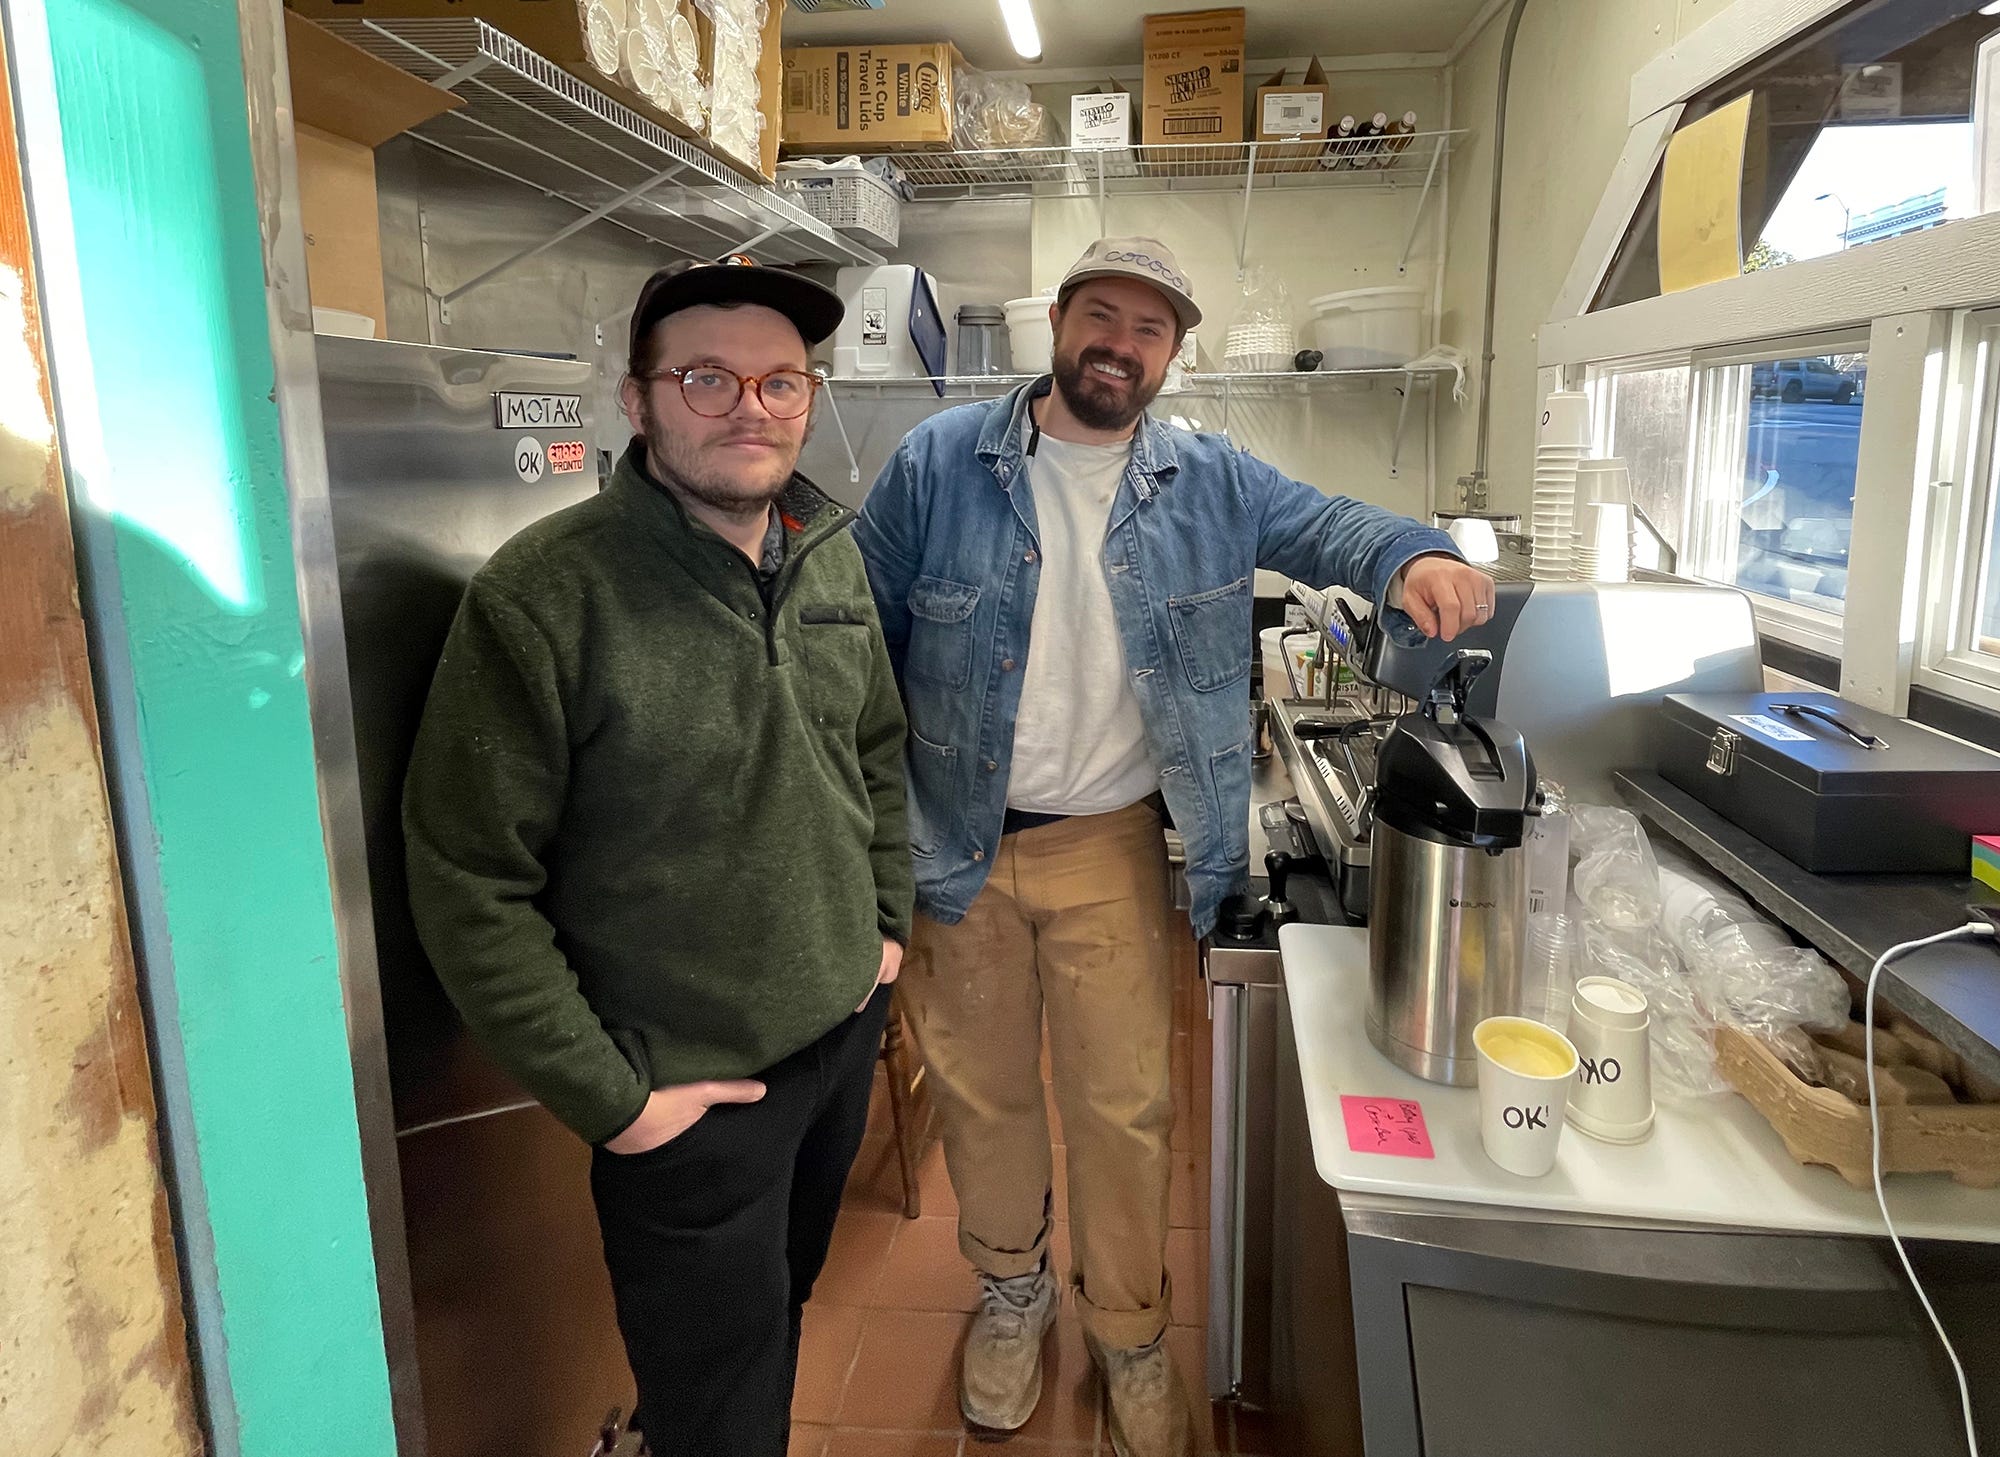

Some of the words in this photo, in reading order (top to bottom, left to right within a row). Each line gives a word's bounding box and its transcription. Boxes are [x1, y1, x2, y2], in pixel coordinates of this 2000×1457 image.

[859, 50, 872, 96] Travel
[875, 58, 888, 86] Hot
[1165, 69, 1202, 86] SUGAR
[899, 72, 909, 107] White
[913, 62, 939, 114] CHOICE
[1171, 90, 1195, 104] RAW
[859, 100, 872, 131] Lids
[873, 90, 888, 122] Cup
[1085, 119, 1100, 129] RAW
[507, 398, 577, 423] MOTAK
[549, 443, 584, 460] CHOCO
[553, 460, 583, 472] PRONTO
